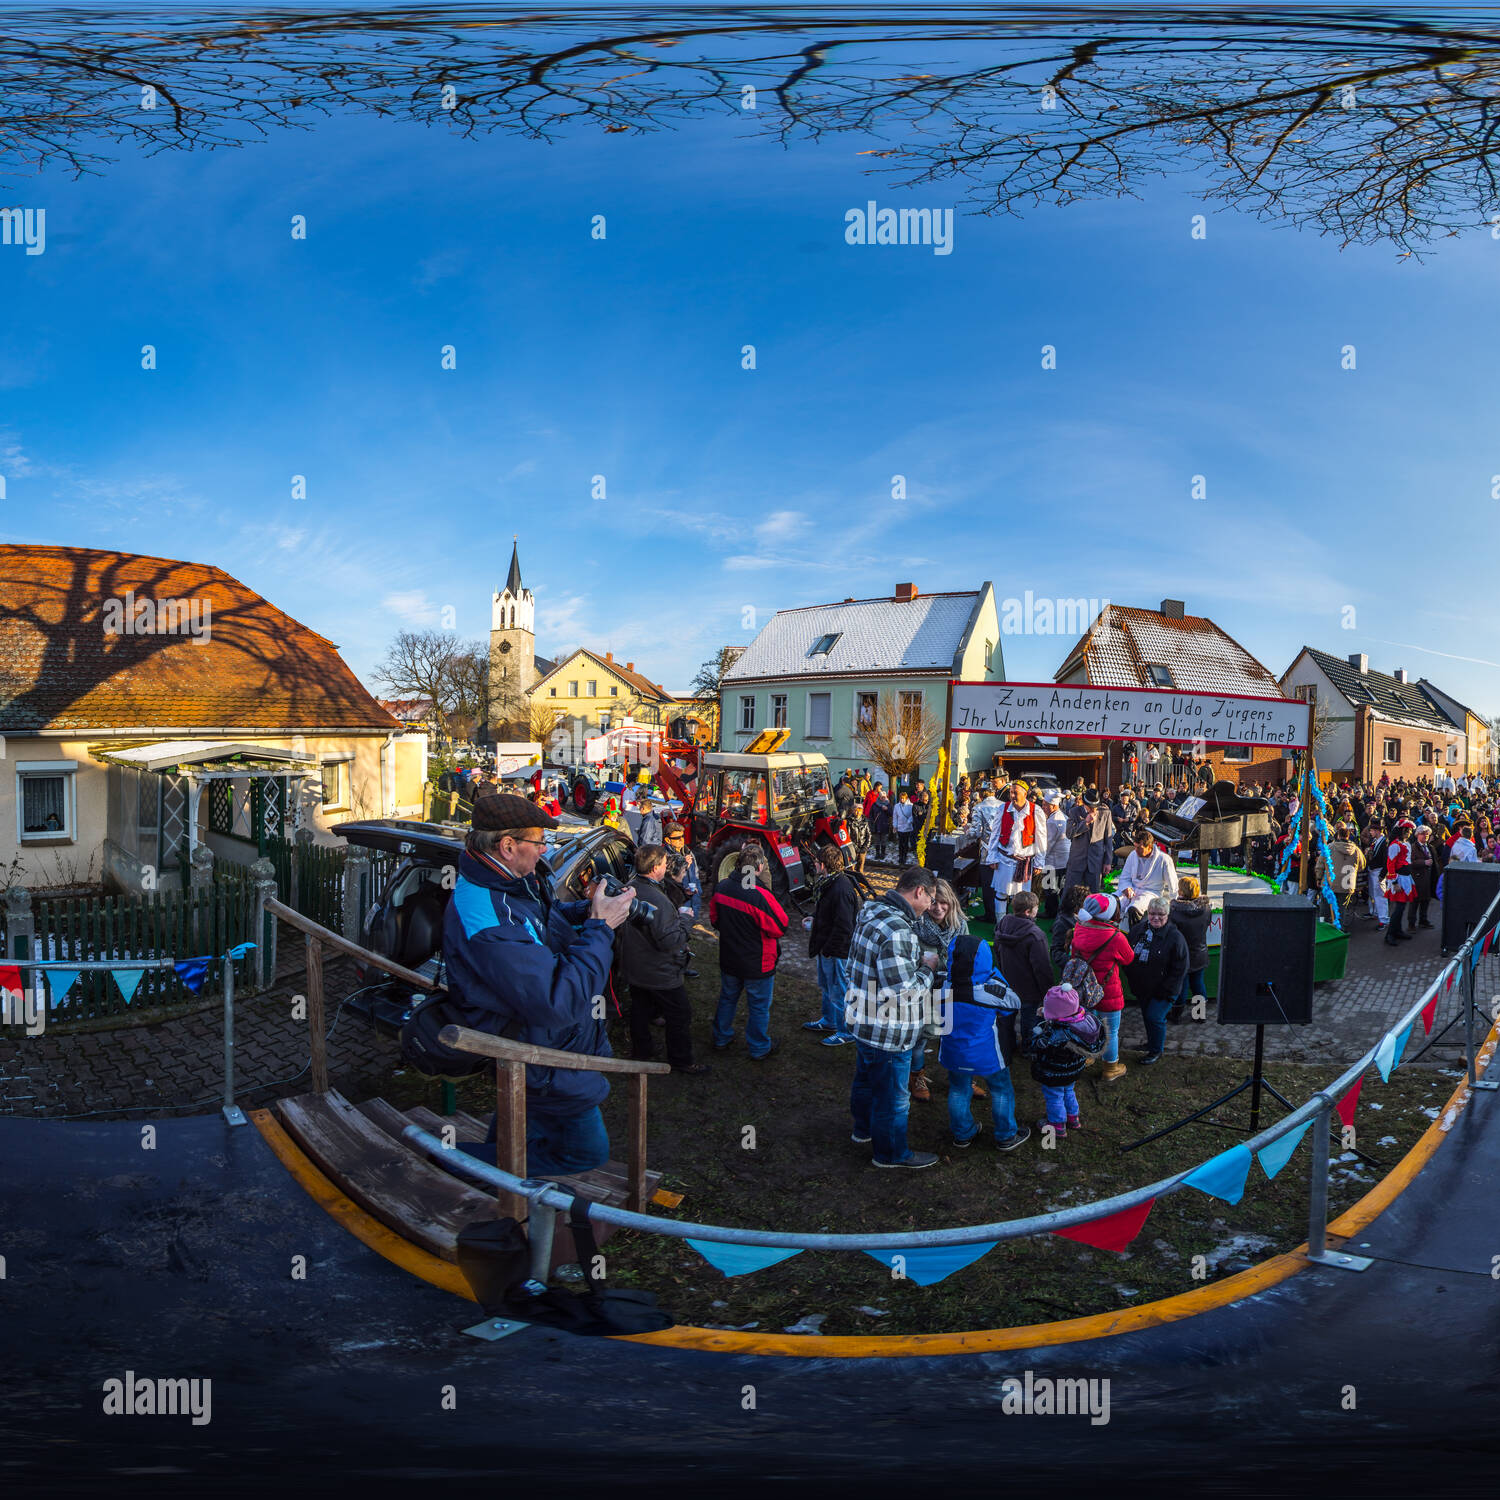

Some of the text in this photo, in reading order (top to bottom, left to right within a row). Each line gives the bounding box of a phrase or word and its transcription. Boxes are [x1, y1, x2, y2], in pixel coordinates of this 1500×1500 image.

[998, 688, 1273, 722] Zum Andenken an Udo Jürgens
[994, 709, 1109, 733] Wunschkonzert
[1120, 721, 1151, 735] zur
[1158, 718, 1219, 738] Glinder
